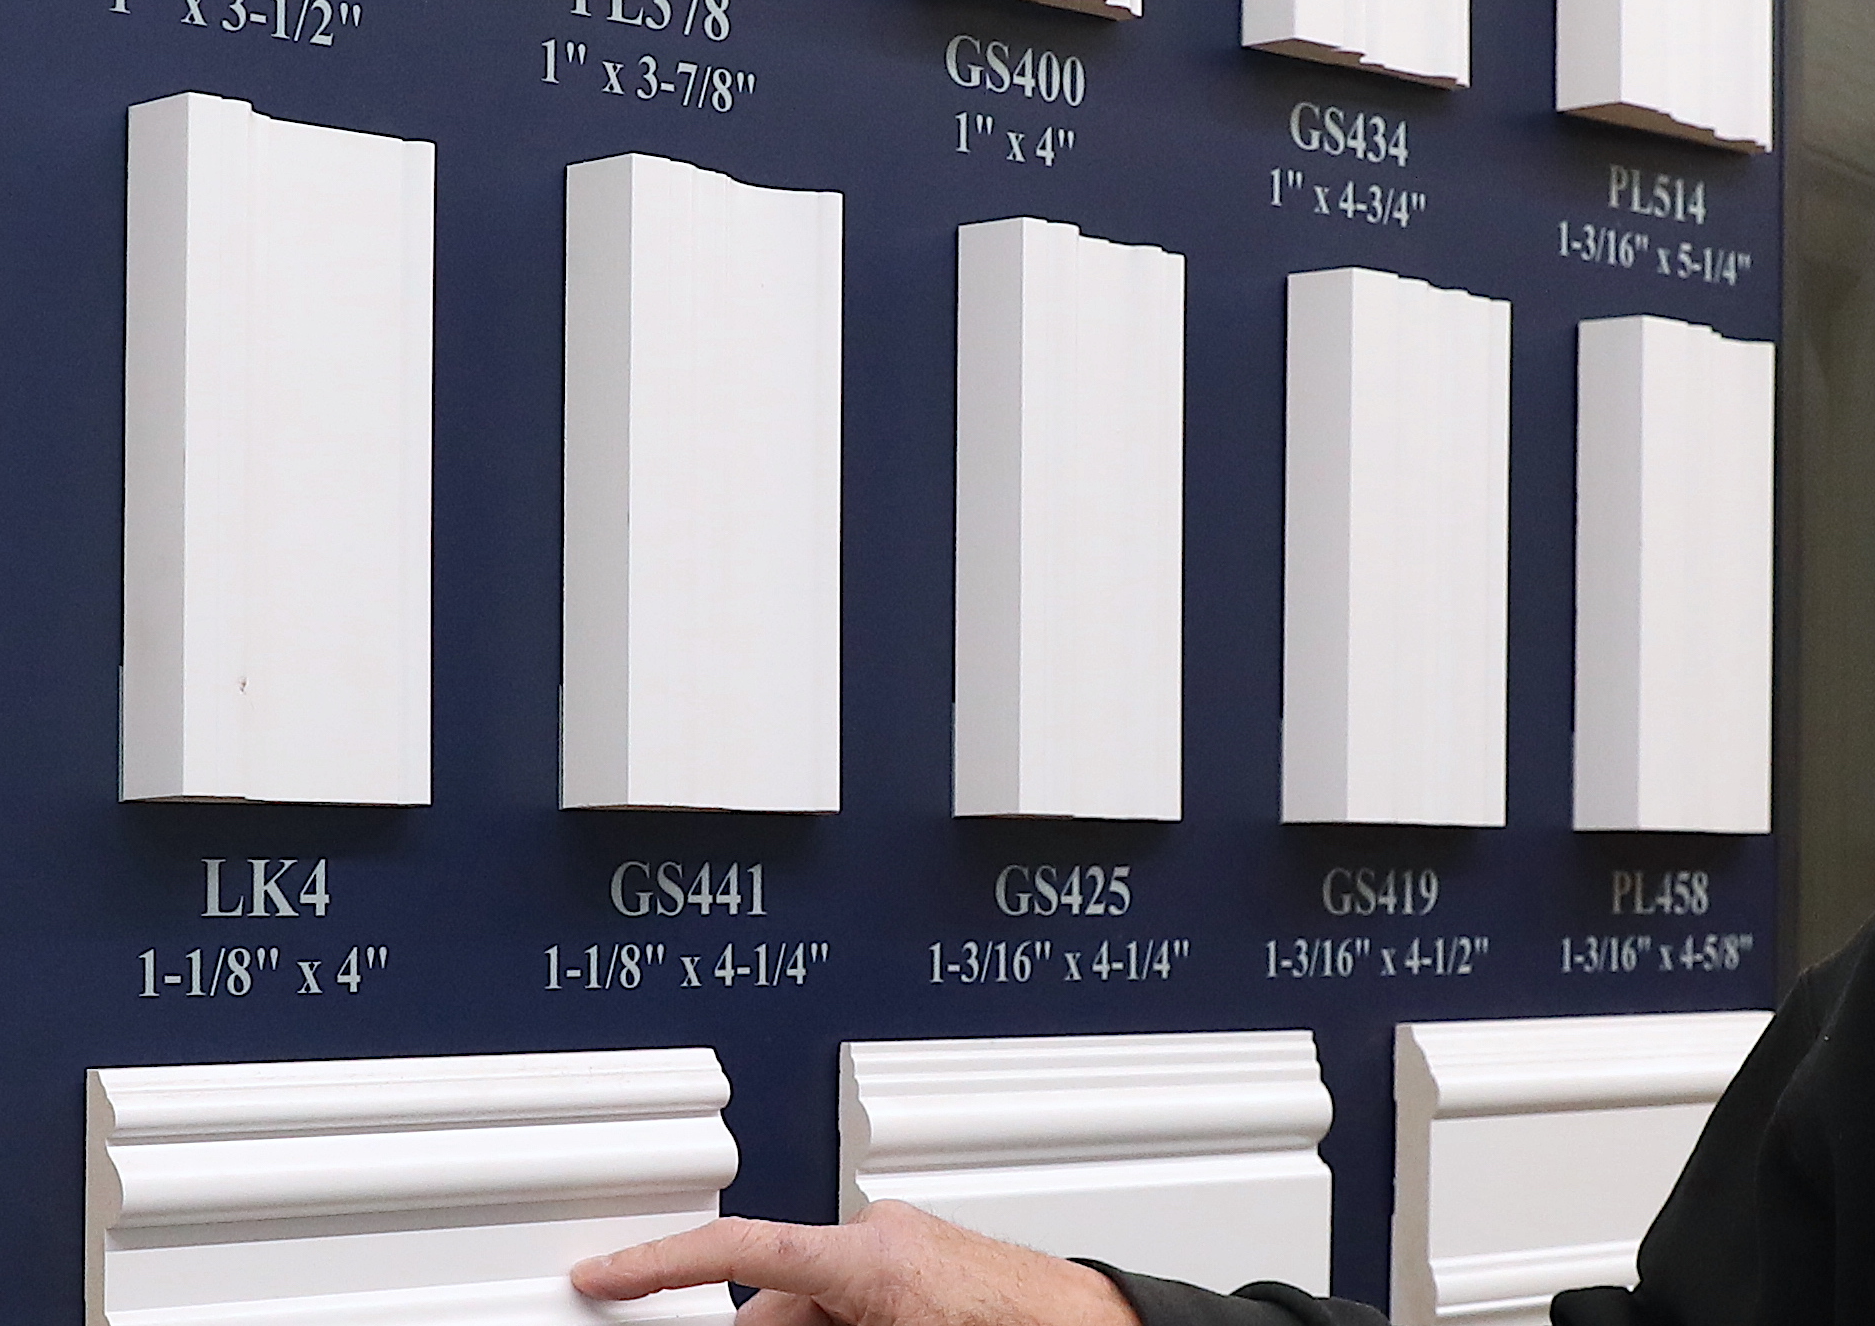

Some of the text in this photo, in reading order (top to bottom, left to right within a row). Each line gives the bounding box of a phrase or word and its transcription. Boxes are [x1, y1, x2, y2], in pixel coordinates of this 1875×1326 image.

[541, 38, 756, 113] 1" x 3-7/8"
[946, 34, 1086, 107] GS400
[955, 111, 1075, 167] 1" x 4"
[1290, 102, 1409, 167] GS434
[1271, 168, 1426, 228] 1" x 4-3/4"
[1608, 163, 1707, 224] PL514
[1559, 220, 1752, 286] 1-3/16" x 5-1/4"
[201, 858, 330, 917] LK4
[610, 861, 768, 917] GS441
[995, 864, 1131, 917] GS425
[1323, 867, 1439, 916] GS419
[1612, 870, 1709, 915] PL458
[138, 946, 388, 997] 1-1/8" x 4"
[544, 942, 829, 990] 1-1/8" x 4-1/4"
[929, 939, 1190, 984] 1-3/16" x 4-1/4"
[1265, 937, 1489, 978] 1-3/16" x 4-1/2"
[1561, 933, 1754, 972] 1-3/16" x 4-5/8"
